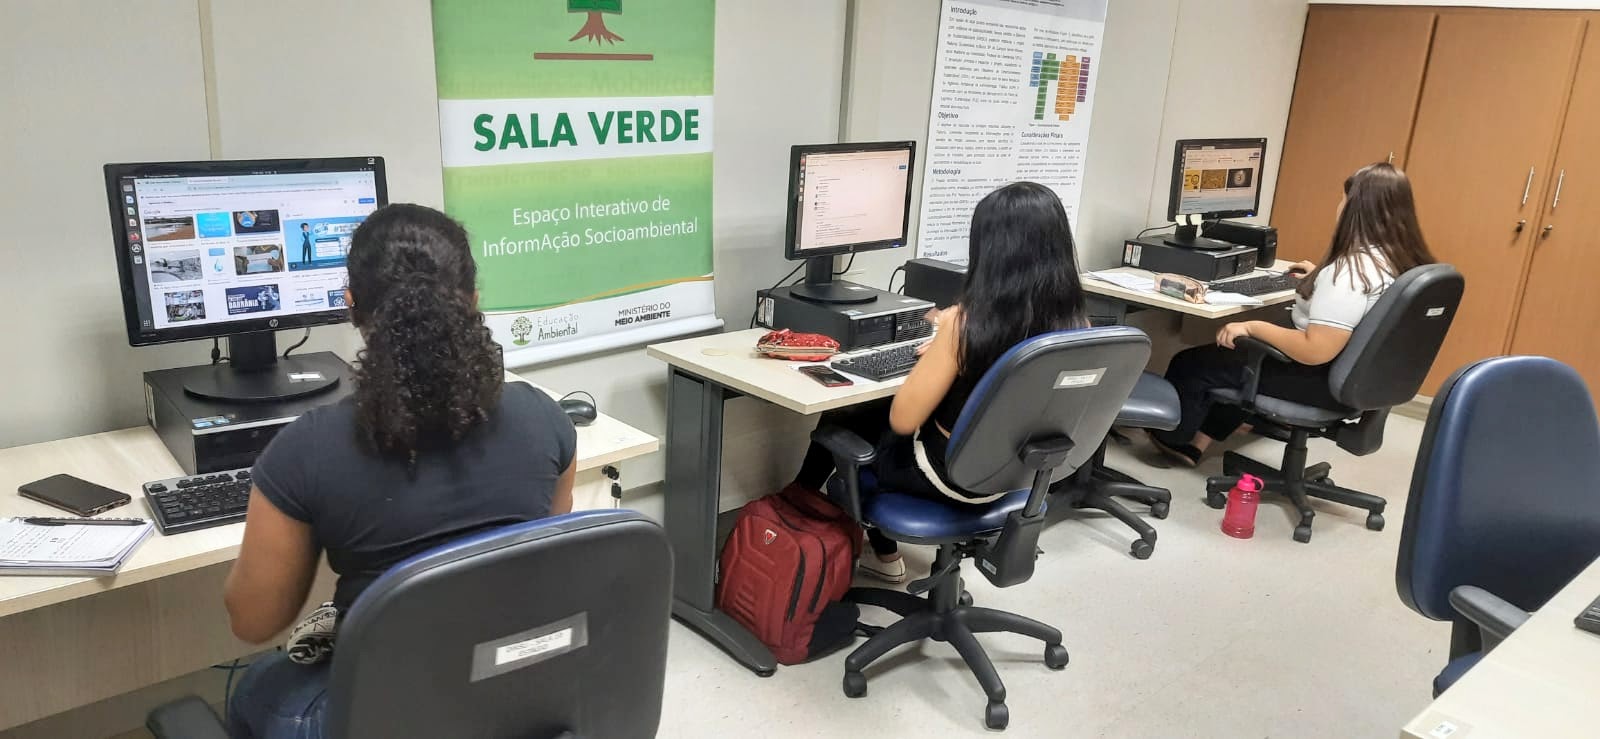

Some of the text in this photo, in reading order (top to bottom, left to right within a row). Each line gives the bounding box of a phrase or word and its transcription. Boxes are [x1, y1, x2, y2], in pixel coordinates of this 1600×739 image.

[937, 111, 959, 120] Objetivo
[473, 108, 700, 152] SALA VERDE
[512, 194, 671, 229] Espaço Interativo de
[482, 216, 699, 257] InformAção Socioambiental
[618, 301, 671, 317] MINISTÉRIO DO
[537, 312, 579, 328] Educação
[614, 310, 671, 327] MEIO AMBIENTE
[537, 322, 579, 342] Ambiental
